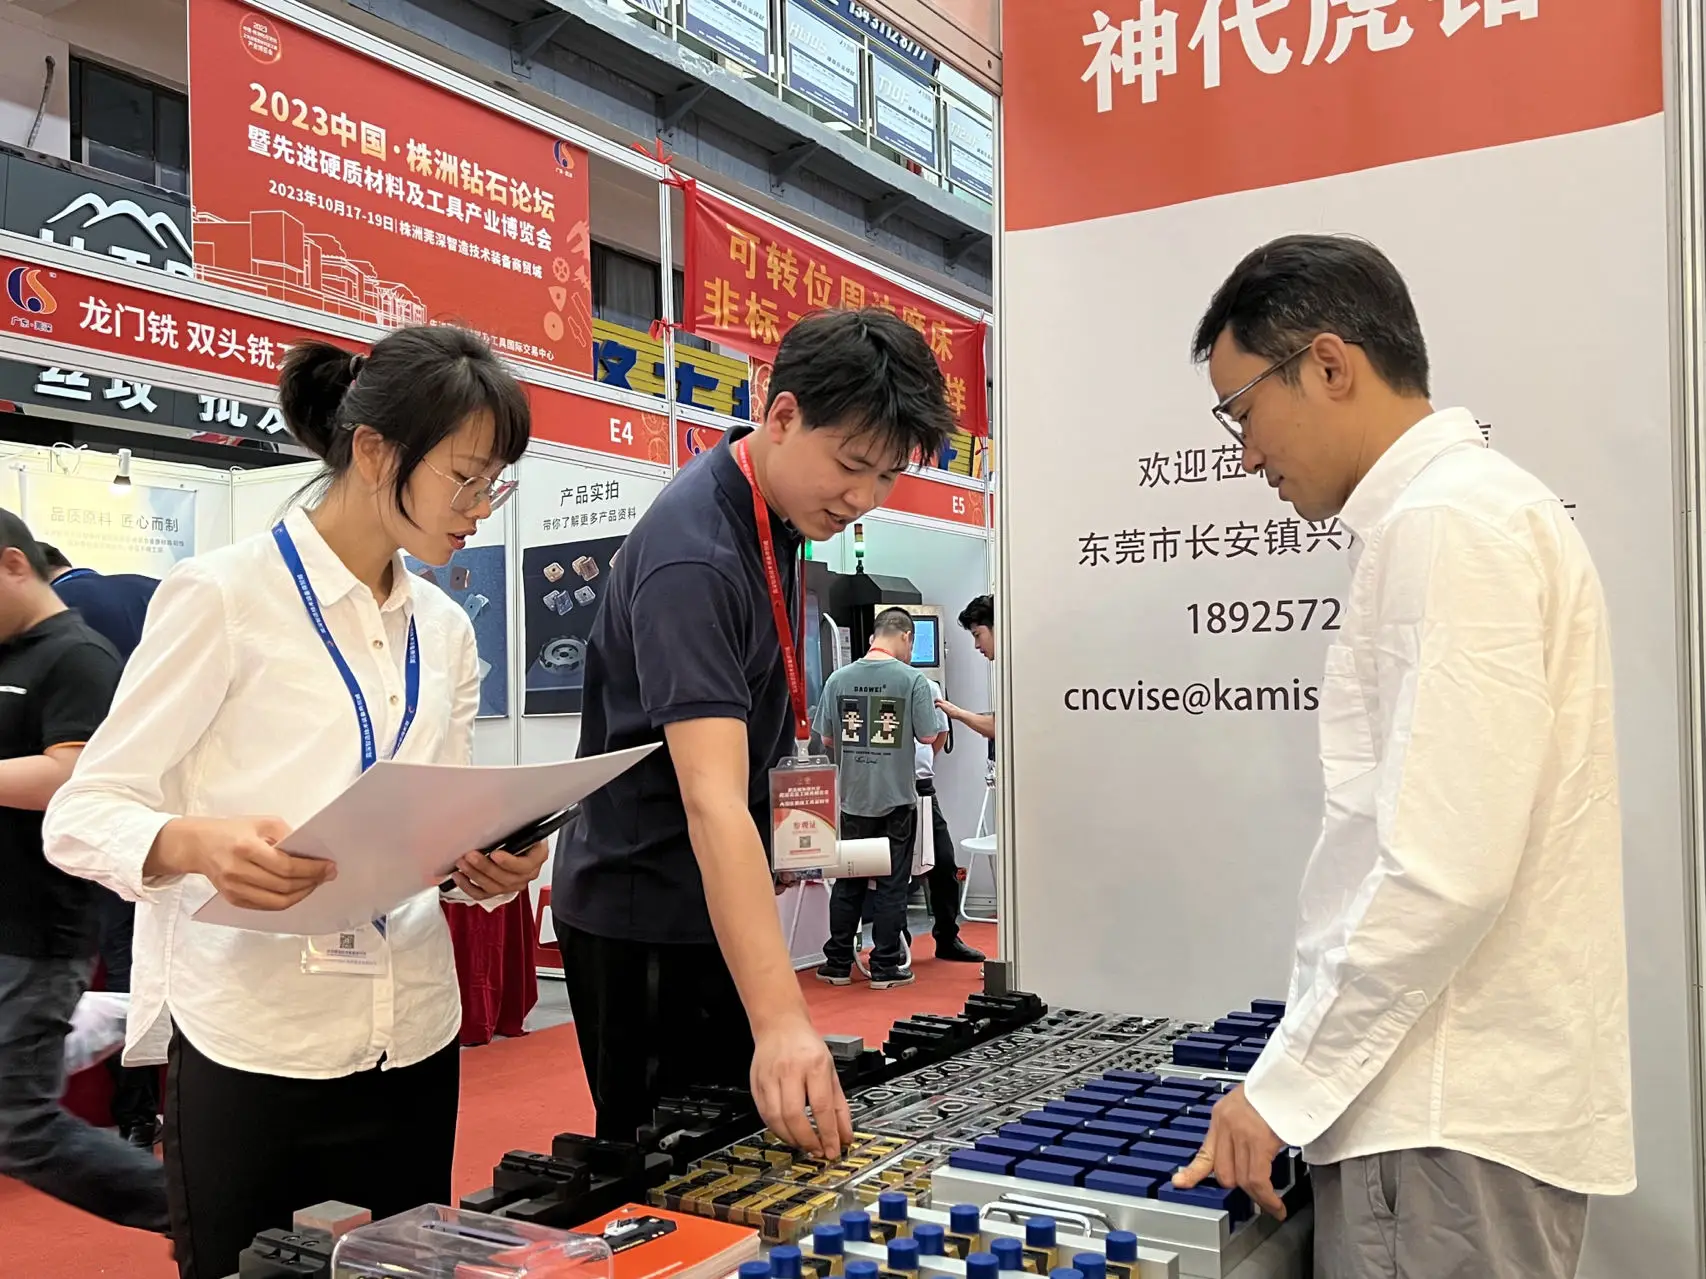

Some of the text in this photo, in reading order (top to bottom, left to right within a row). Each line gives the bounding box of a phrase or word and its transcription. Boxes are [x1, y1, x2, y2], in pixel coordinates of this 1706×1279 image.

[1080, 0, 1540, 113] 神代虎
[247, 124, 553, 252] 暨先进硬质材料及工具产业博览会
[726, 223, 953, 362] 可转位周床
[79, 295, 179, 350] 龙门铣
[609, 417, 634, 446] E4
[1138, 443, 1265, 488] 欢迎莅
[560, 480, 620, 507] 产品实拍
[952, 495, 966, 516] E5
[50, 506, 179, 533] 品质原料 匠心而制
[542, 507, 637, 532] 带你了解更多产品资料
[1078, 516, 1356, 567] 东莞市长安镇兴
[1187, 597, 1348, 635] 1892572
[1063, 677, 1325, 716] cncvise@kamis
